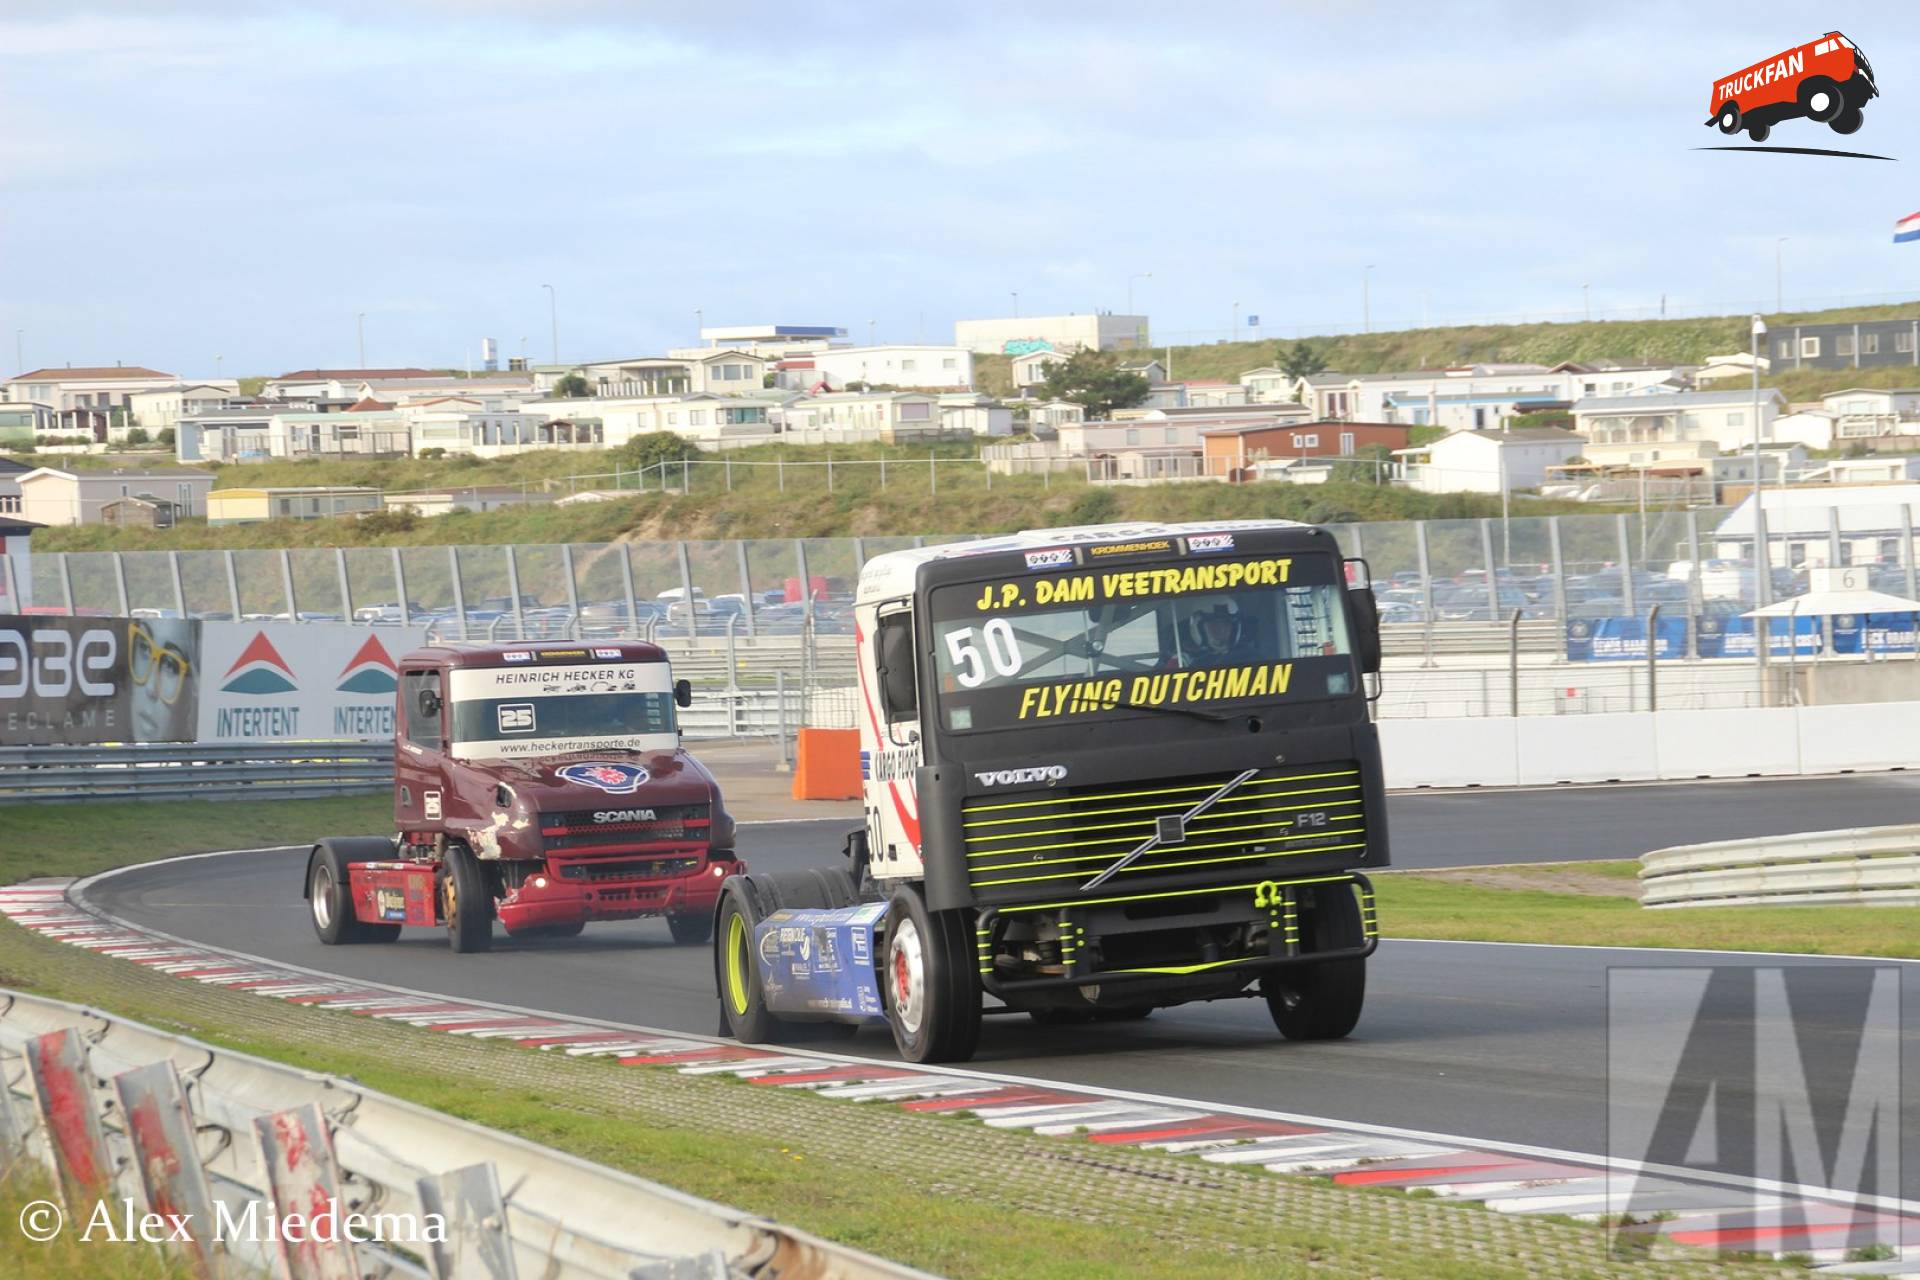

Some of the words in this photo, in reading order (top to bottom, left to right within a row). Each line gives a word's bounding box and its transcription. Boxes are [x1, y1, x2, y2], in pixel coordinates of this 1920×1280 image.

[1090, 540, 1170, 556] KROMMENHOEK
[976, 584, 1027, 611] J.P.
[1035, 575, 1095, 605] DAM
[1102, 558, 1293, 599] VEETRANSPORT
[1842, 569, 1856, 589] 6
[943, 617, 1023, 689] 50
[495, 671, 560, 685] HEINRICH
[563, 669, 614, 682] HECKER
[618, 669, 636, 680] KG
[1017, 678, 1123, 720] FLYING
[1129, 663, 1293, 707] DUTCHMAN
[216, 706, 300, 738] INTERTENT
[500, 709, 533, 728] 25
[499, 736, 641, 753] www.heckertransporte.de
[974, 764, 1069, 787] VOLVO
[592, 808, 657, 824] SCANIA
[1297, 812, 1327, 827] F12
